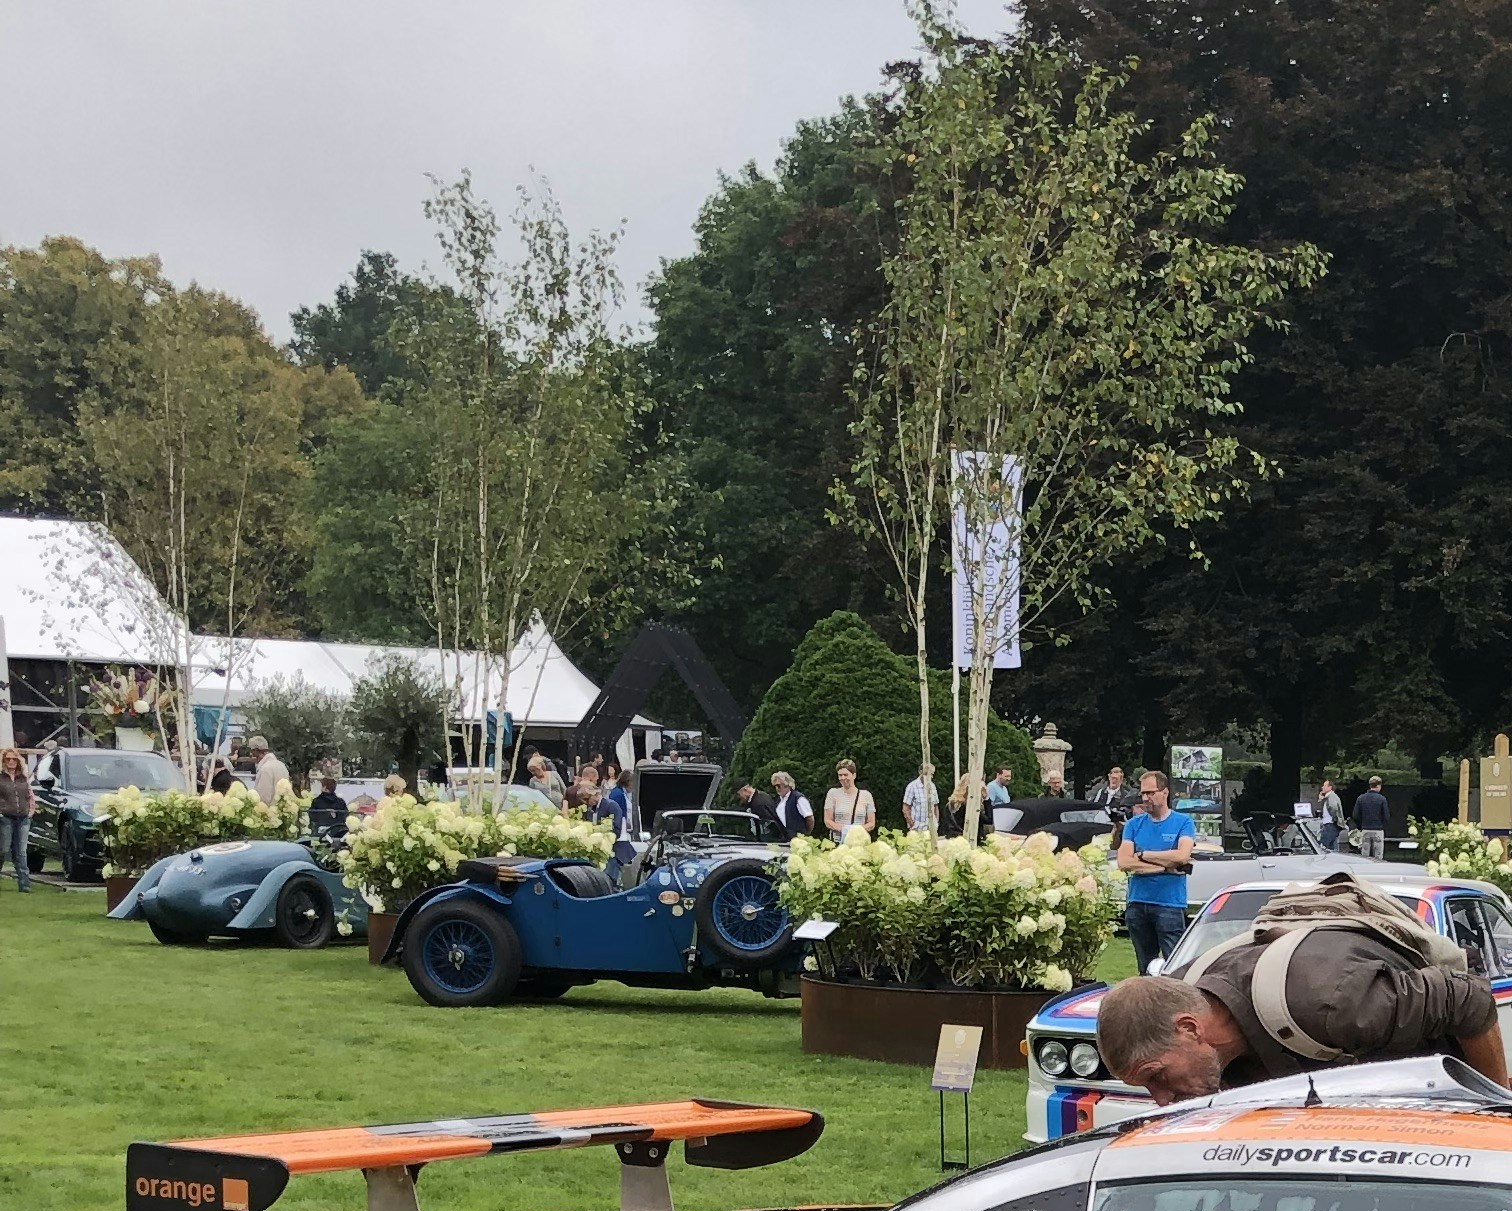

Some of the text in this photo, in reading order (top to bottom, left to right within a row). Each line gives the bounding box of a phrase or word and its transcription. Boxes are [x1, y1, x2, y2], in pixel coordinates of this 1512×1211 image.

[1295, 1122, 1455, 1136] Norman Simon
[1202, 1144, 1472, 1168] dailysportscar.com
[135, 1177, 216, 1207] orange
